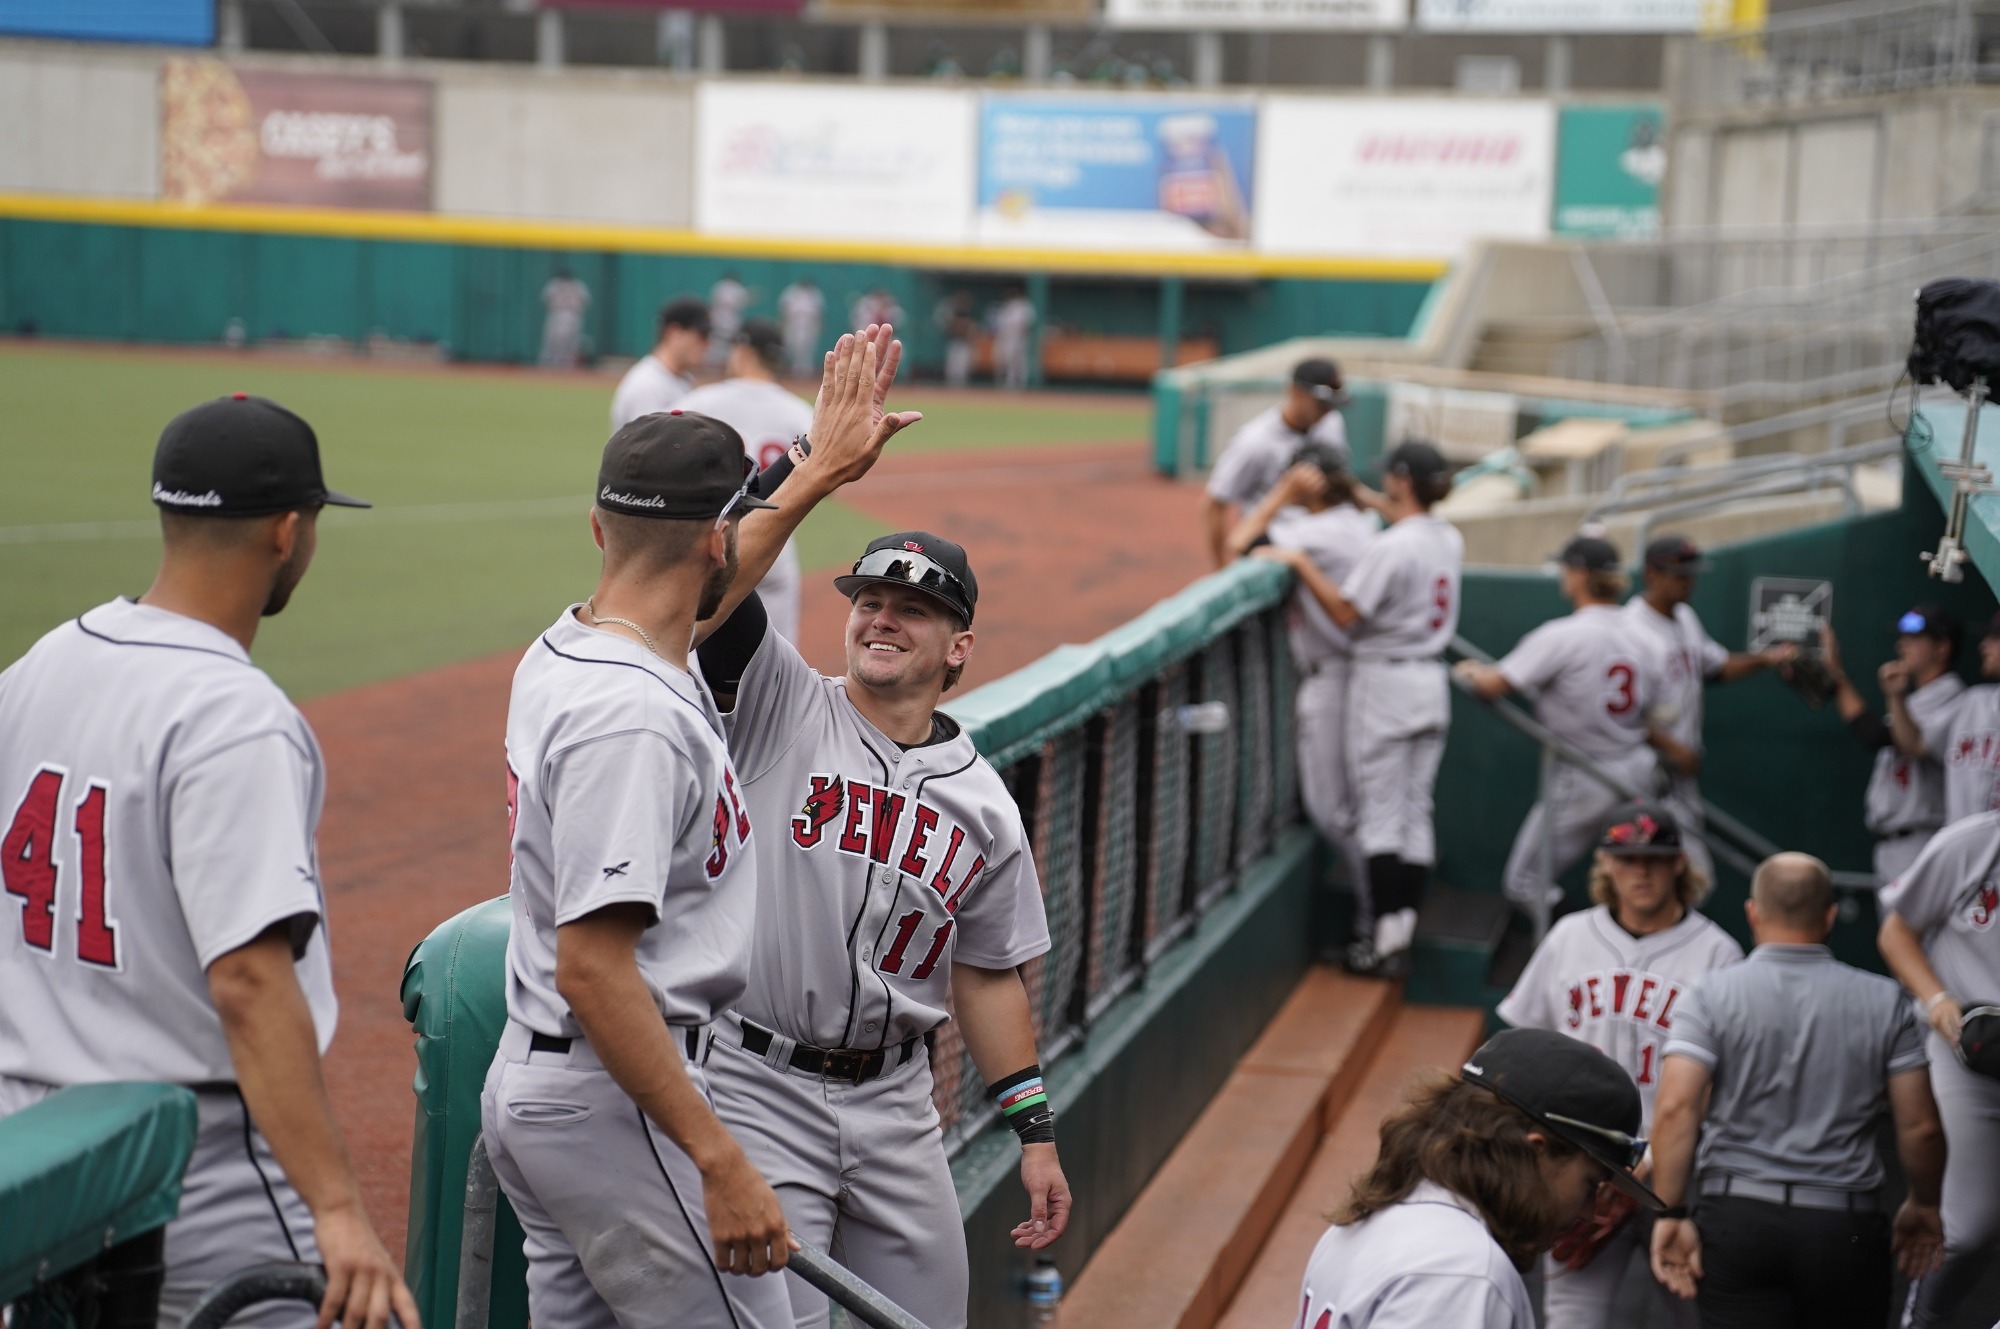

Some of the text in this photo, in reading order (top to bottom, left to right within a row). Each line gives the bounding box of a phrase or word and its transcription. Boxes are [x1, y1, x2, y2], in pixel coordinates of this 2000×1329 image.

[152, 480, 223, 507] Cardinals
[601, 484, 666, 508] Cardinals
[1604, 660, 1637, 716] 3
[1, 764, 122, 971] 41
[791, 773, 987, 917] JEWELL
[877, 906, 956, 981] 11
